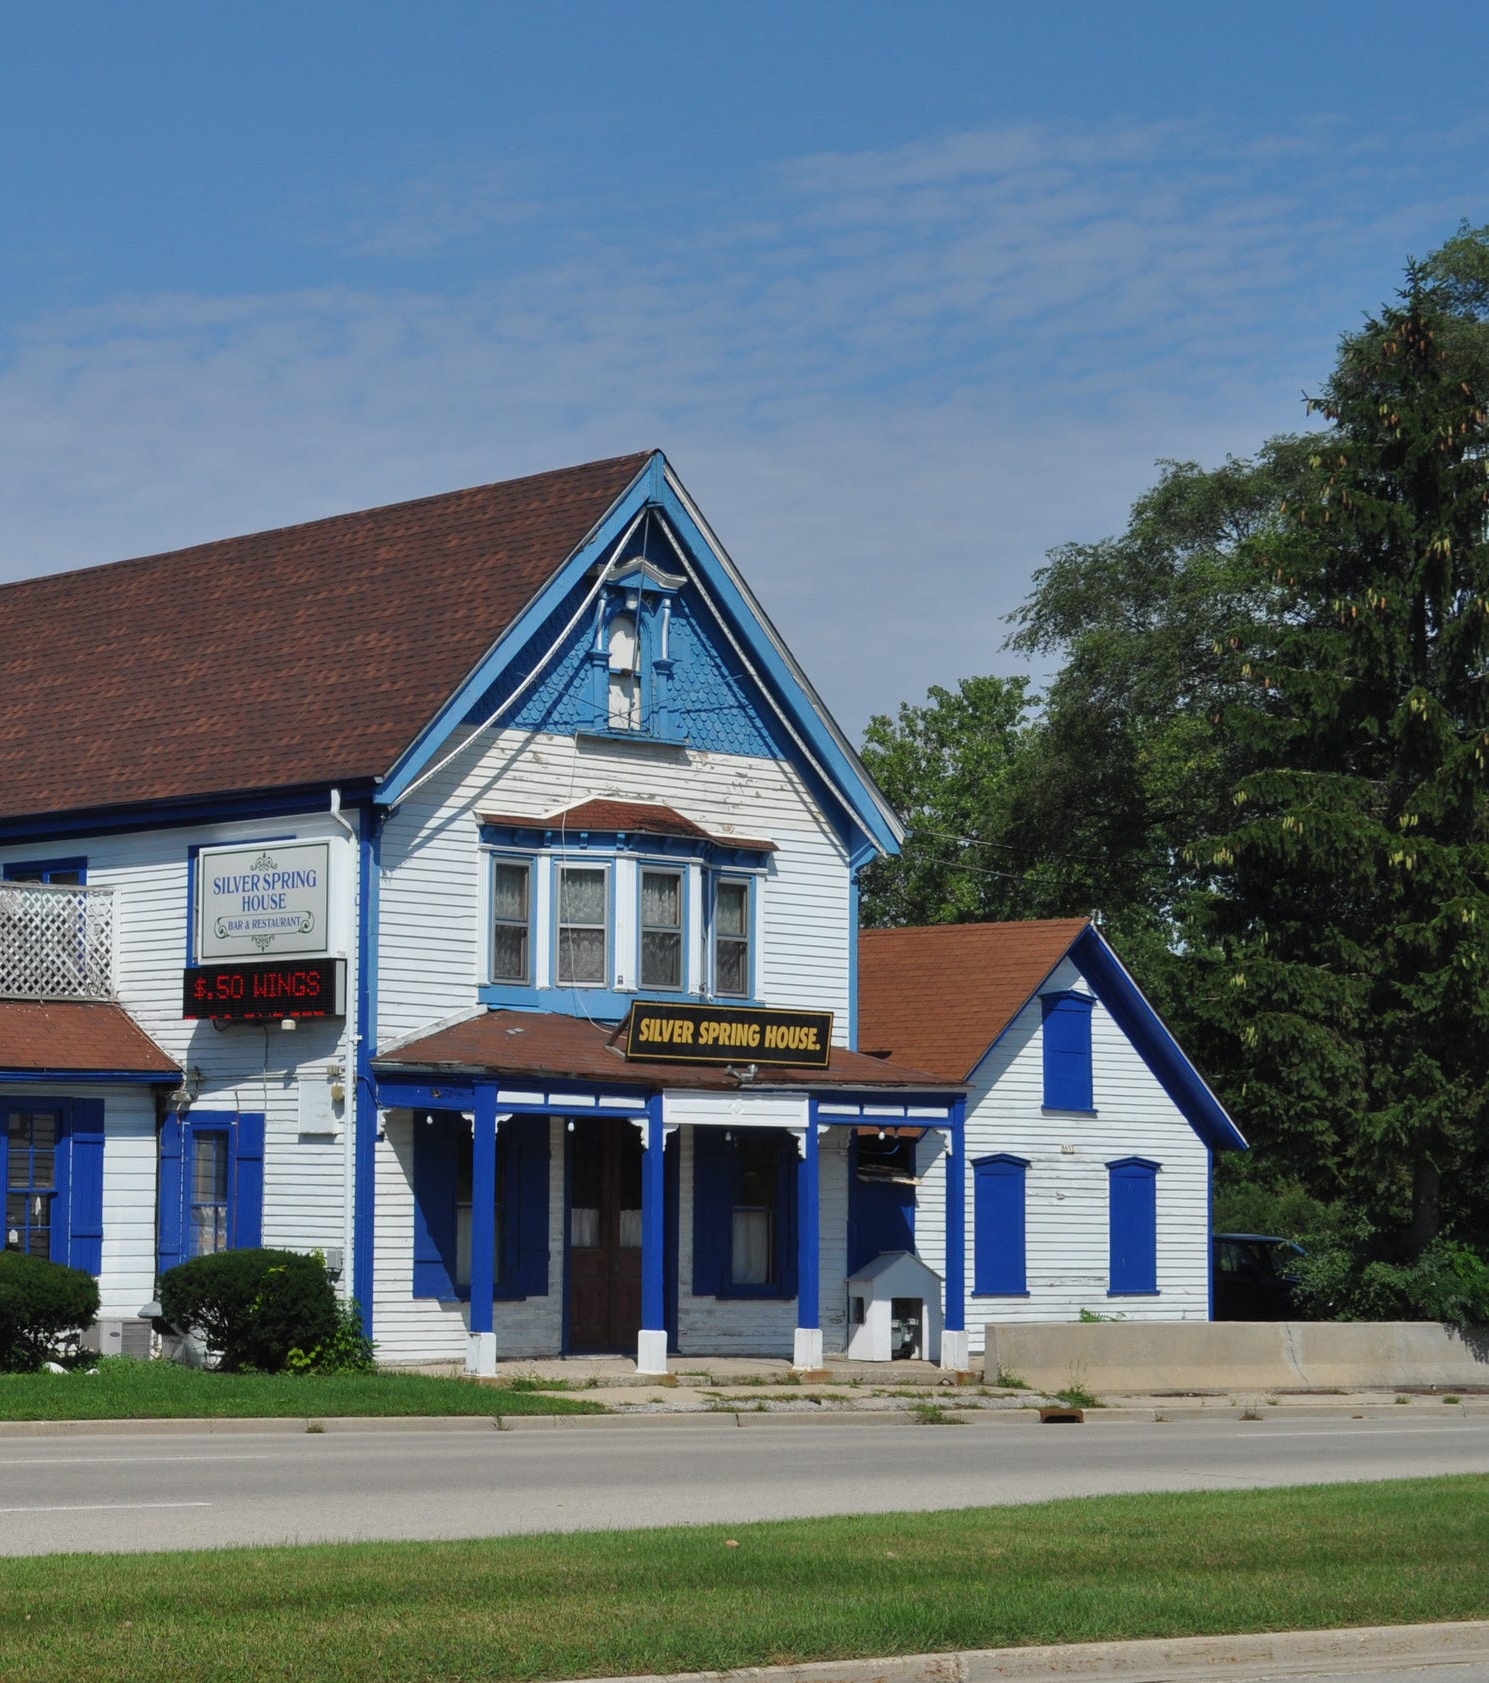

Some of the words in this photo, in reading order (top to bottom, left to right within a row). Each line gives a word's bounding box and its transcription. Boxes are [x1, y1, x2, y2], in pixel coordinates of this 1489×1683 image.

[213, 874, 260, 895] SILVER
[263, 870, 317, 891] SPRING
[242, 893, 286, 912] HOUSE
[228, 920, 244, 930] BAR
[245, 920, 251, 930] &
[252, 916, 301, 930] RESTAURANT
[193, 974, 244, 1000] $.50
[253, 971, 321, 998] WINGS
[639, 1018, 694, 1043] SILVER
[698, 1021, 760, 1047] SPRING
[764, 1025, 821, 1051] HOUSE.
